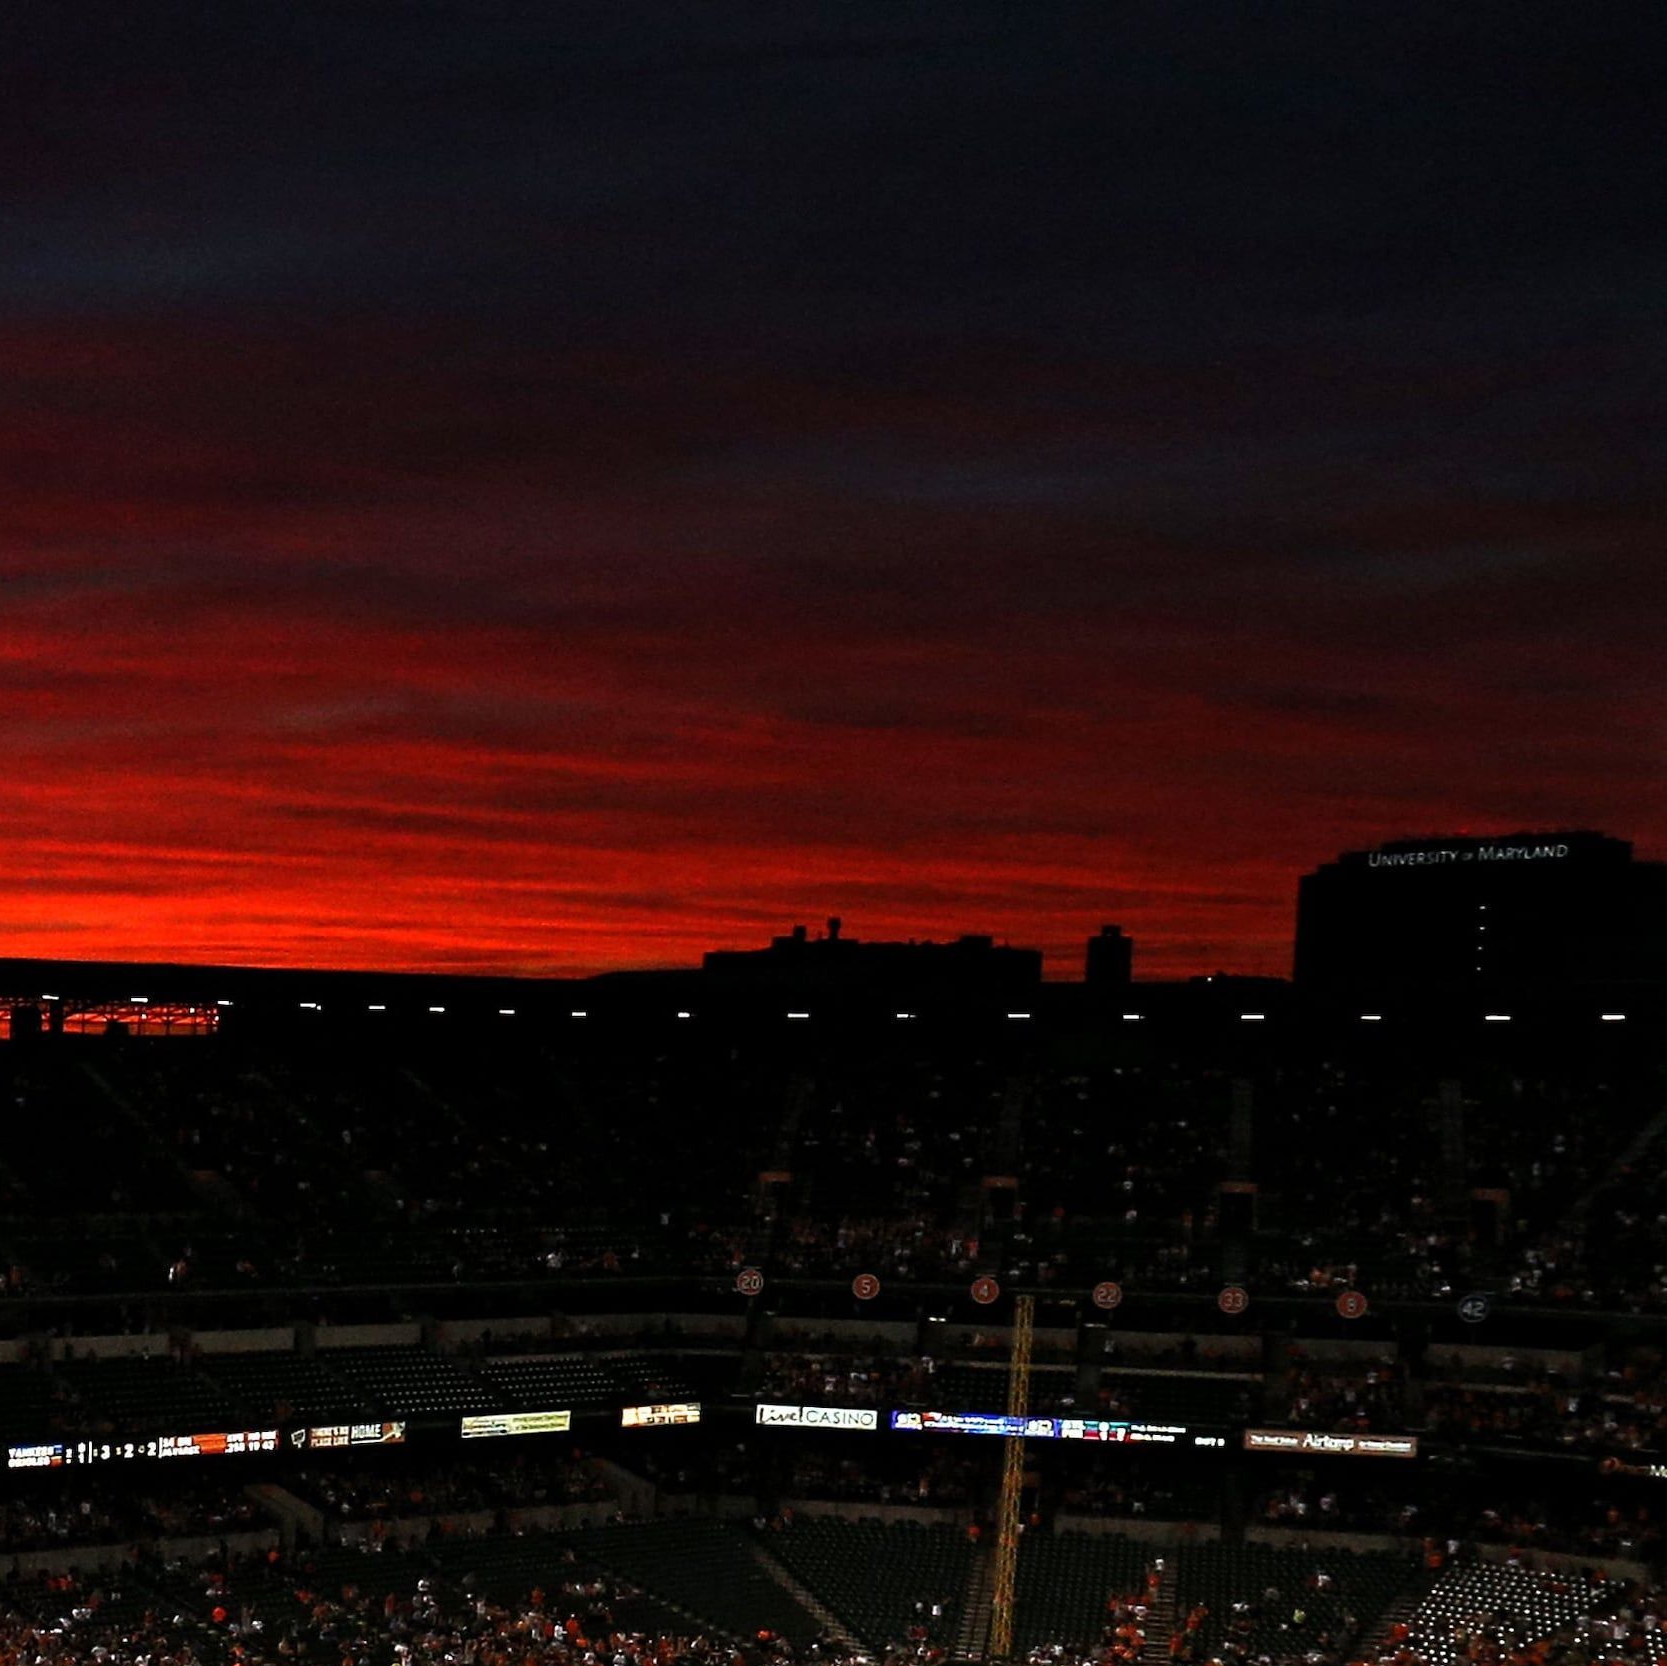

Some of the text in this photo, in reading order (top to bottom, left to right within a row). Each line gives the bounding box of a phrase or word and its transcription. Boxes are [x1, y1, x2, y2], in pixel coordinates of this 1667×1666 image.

[1368, 849, 1458, 868] UNIVERSITY
[1478, 844, 1571, 862] MARYLAND
[742, 1275, 760, 1290] 20
[862, 1279, 871, 1294] 5
[980, 1283, 990, 1297] 4
[1097, 1289, 1117, 1304] 22
[1224, 1292, 1243, 1308] 33
[1462, 1300, 1485, 1317] 42
[806, 1410, 874, 1427] CASINO
